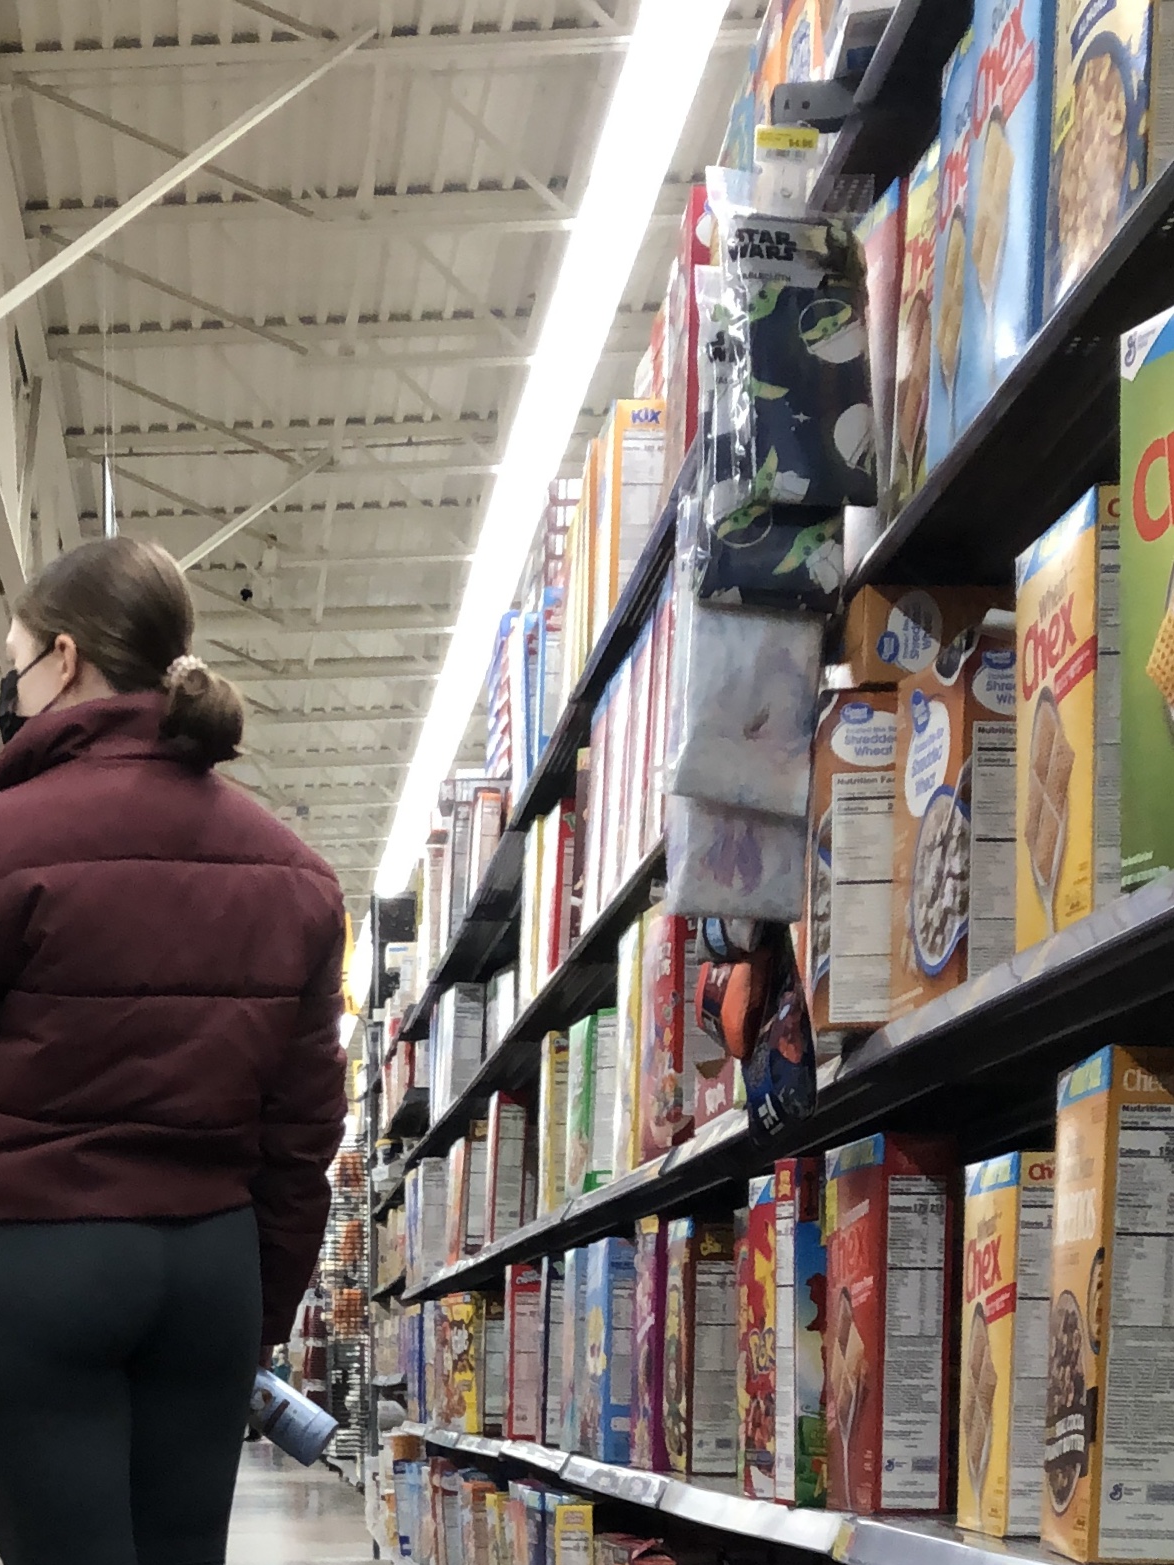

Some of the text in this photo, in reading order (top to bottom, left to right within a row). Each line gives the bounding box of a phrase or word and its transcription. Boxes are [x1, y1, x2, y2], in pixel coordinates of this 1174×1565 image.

[728, 244, 796, 262] WARS
[1022, 591, 1077, 701] Chex
[965, 1234, 1002, 1304] Chex
